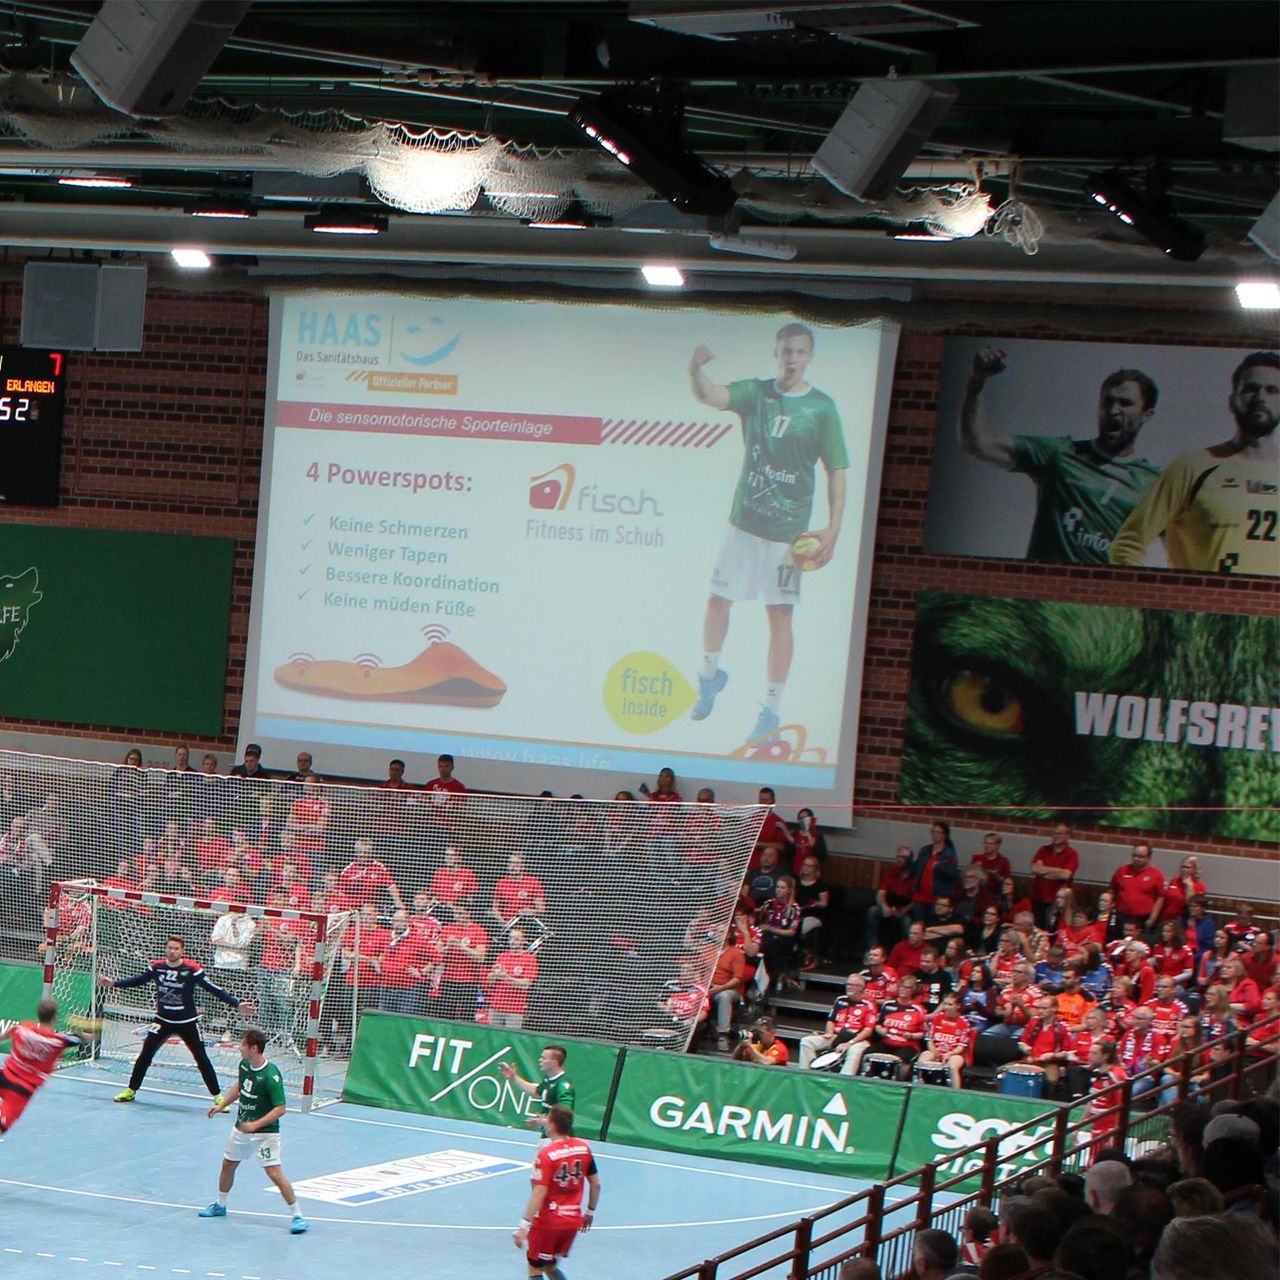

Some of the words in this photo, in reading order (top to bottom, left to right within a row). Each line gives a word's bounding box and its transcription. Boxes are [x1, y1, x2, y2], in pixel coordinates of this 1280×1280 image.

[298, 310, 383, 348] HAAS
[49, 352, 63, 378] 7
[296, 351, 313, 364] Das
[316, 353, 380, 367] Sanitätshaus
[6, 379, 55, 394] ERLANGEN
[308, 408, 333, 423] Die
[336, 410, 458, 431] sensomotorische
[461, 416, 554, 439] Sporteinlage
[306, 462, 319, 483] 4
[326, 463, 474, 495] Powerspots:
[578, 483, 665, 518] fisch
[329, 516, 374, 534] Keine
[378, 519, 469, 541] Schmerzen
[525, 518, 586, 542] Fitness
[590, 525, 610, 545] im
[615, 524, 666, 548] Schuh
[1246, 508, 1278, 543] 22
[327, 541, 396, 563] Weniger
[400, 546, 448, 567] Tapen
[325, 566, 389, 586] Bessere
[393, 571, 501, 595] Koordination
[323, 592, 369, 610] Keine
[373, 596, 431, 615] müden
[435, 600, 476, 619] Füße
[621, 667, 673, 697] fisch
[622, 697, 668, 718] inside
[409, 1032, 474, 1075] FIT
[649, 1094, 850, 1155] GARMIN
[552, 1159, 583, 1187] 44
